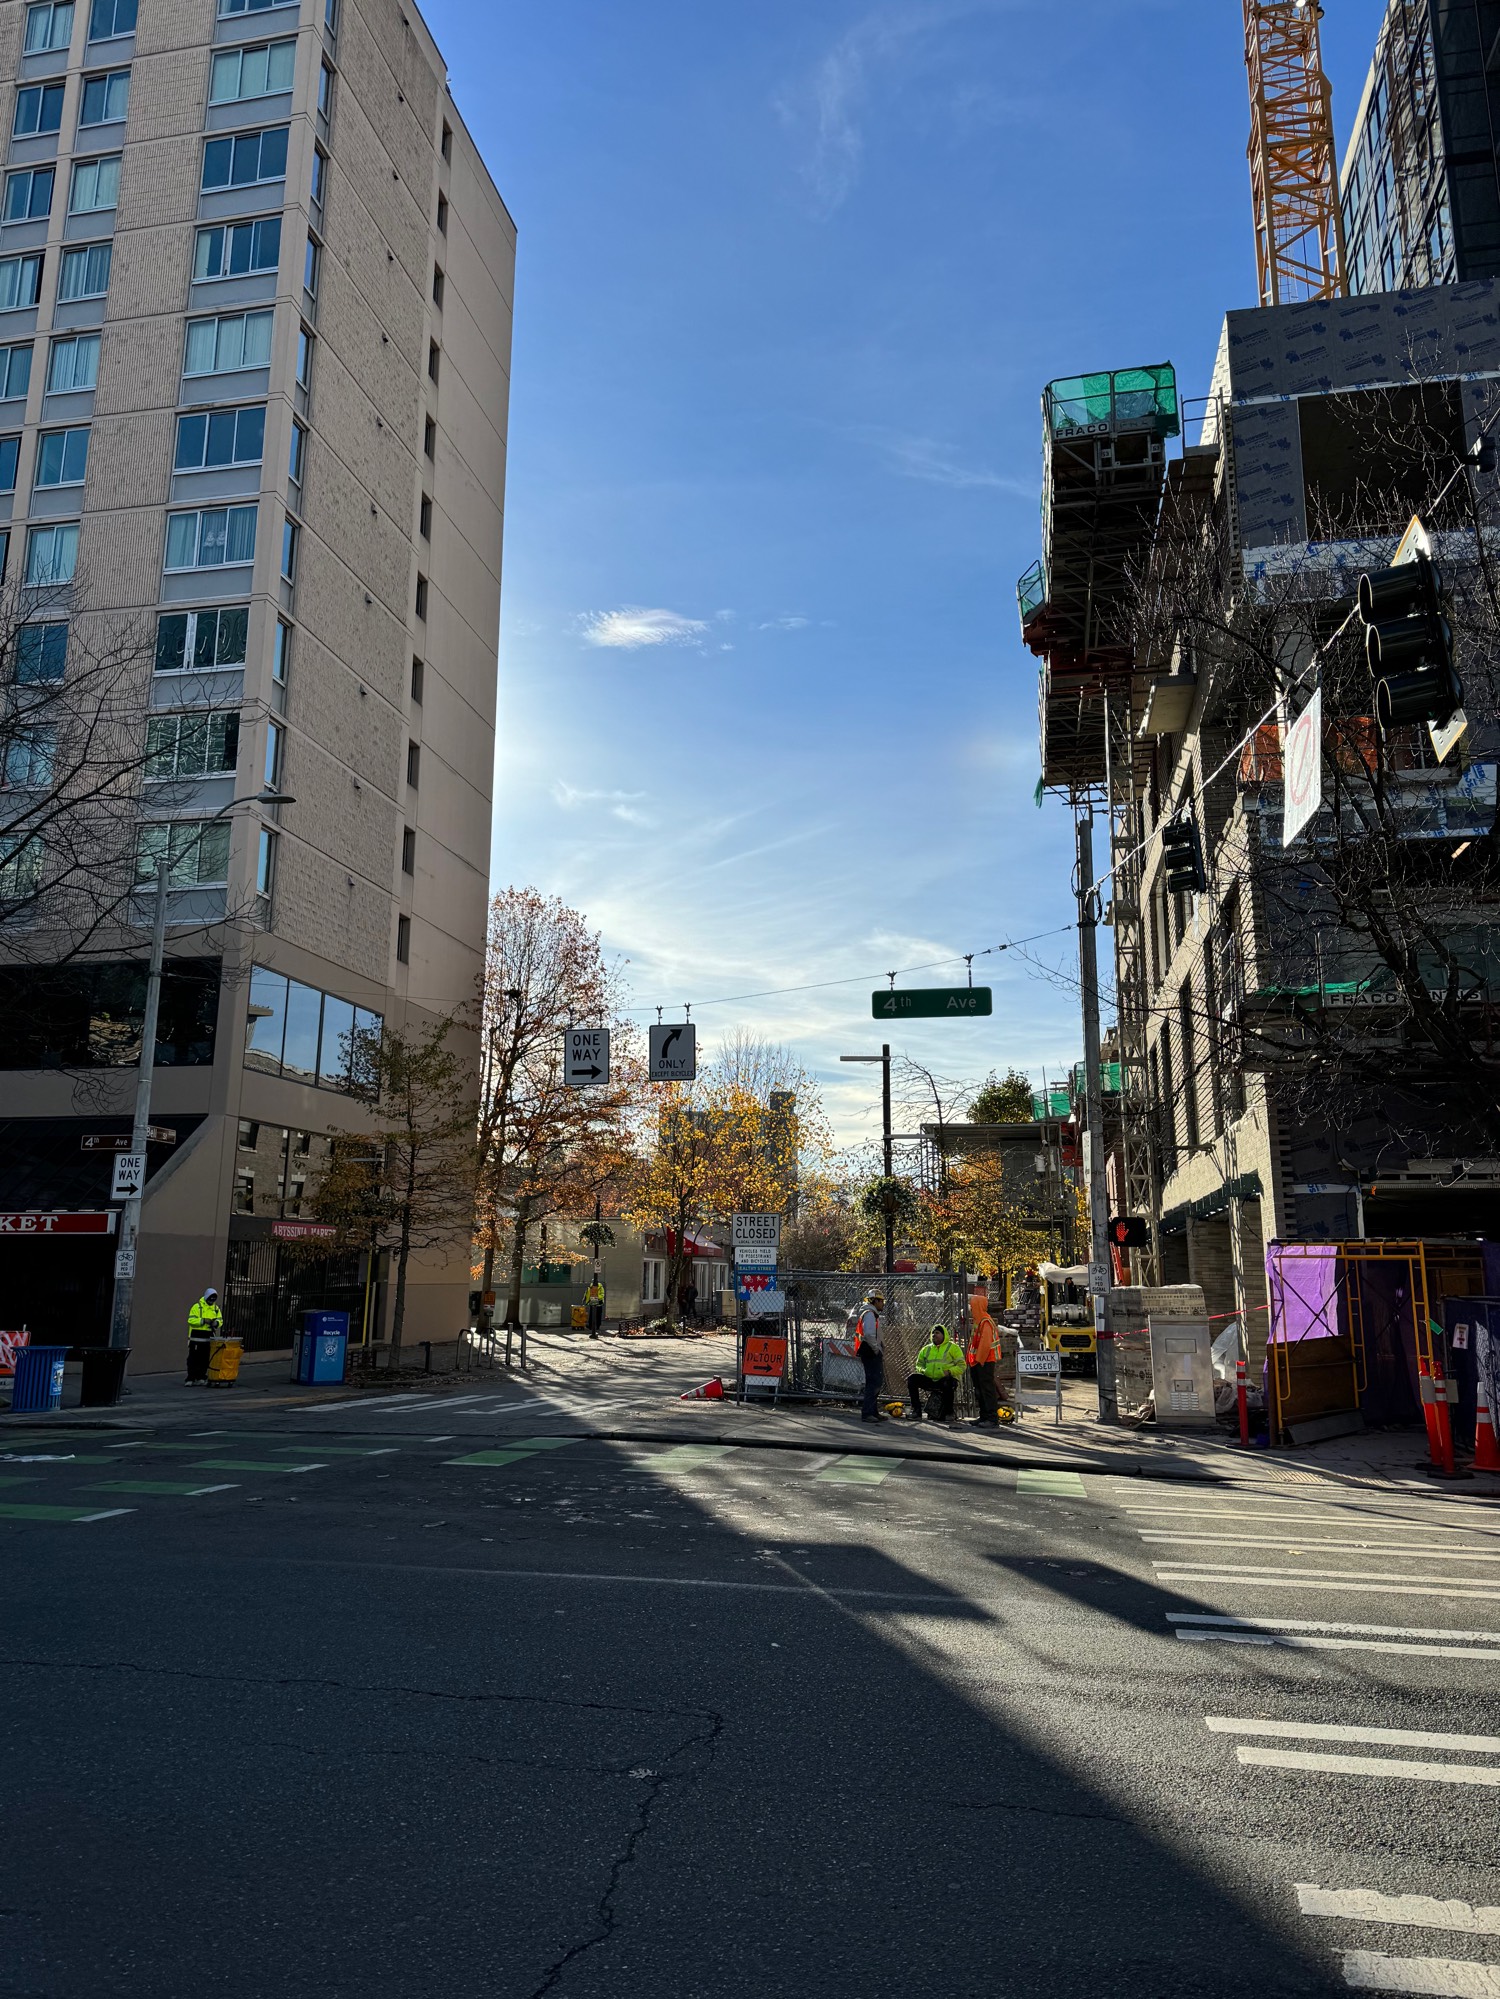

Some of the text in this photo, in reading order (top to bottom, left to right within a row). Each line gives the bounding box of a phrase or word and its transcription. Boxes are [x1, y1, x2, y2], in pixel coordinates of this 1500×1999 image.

[1056, 423, 1108, 438] FRACO
[883, 996, 977, 1012] 4th Ave
[1330, 993, 1397, 1005] FRACO
[573, 1034, 601, 1047] ONE
[572, 1048, 601, 1061] WAY
[658, 1059, 686, 1069] ONLY
[651, 1070, 669, 1078] EXCEPT
[85, 1136, 128, 1148] 4th Ave
[120, 1157, 141, 1168] ONE
[118, 1169, 141, 1181] WAY
[0, 1215, 59, 1231] KET
[736, 1216, 777, 1227] STREET
[273, 1225, 307, 1237] ABYSSINIA
[735, 1228, 776, 1239] CLOSED
[747, 1352, 783, 1364] DETOUR
